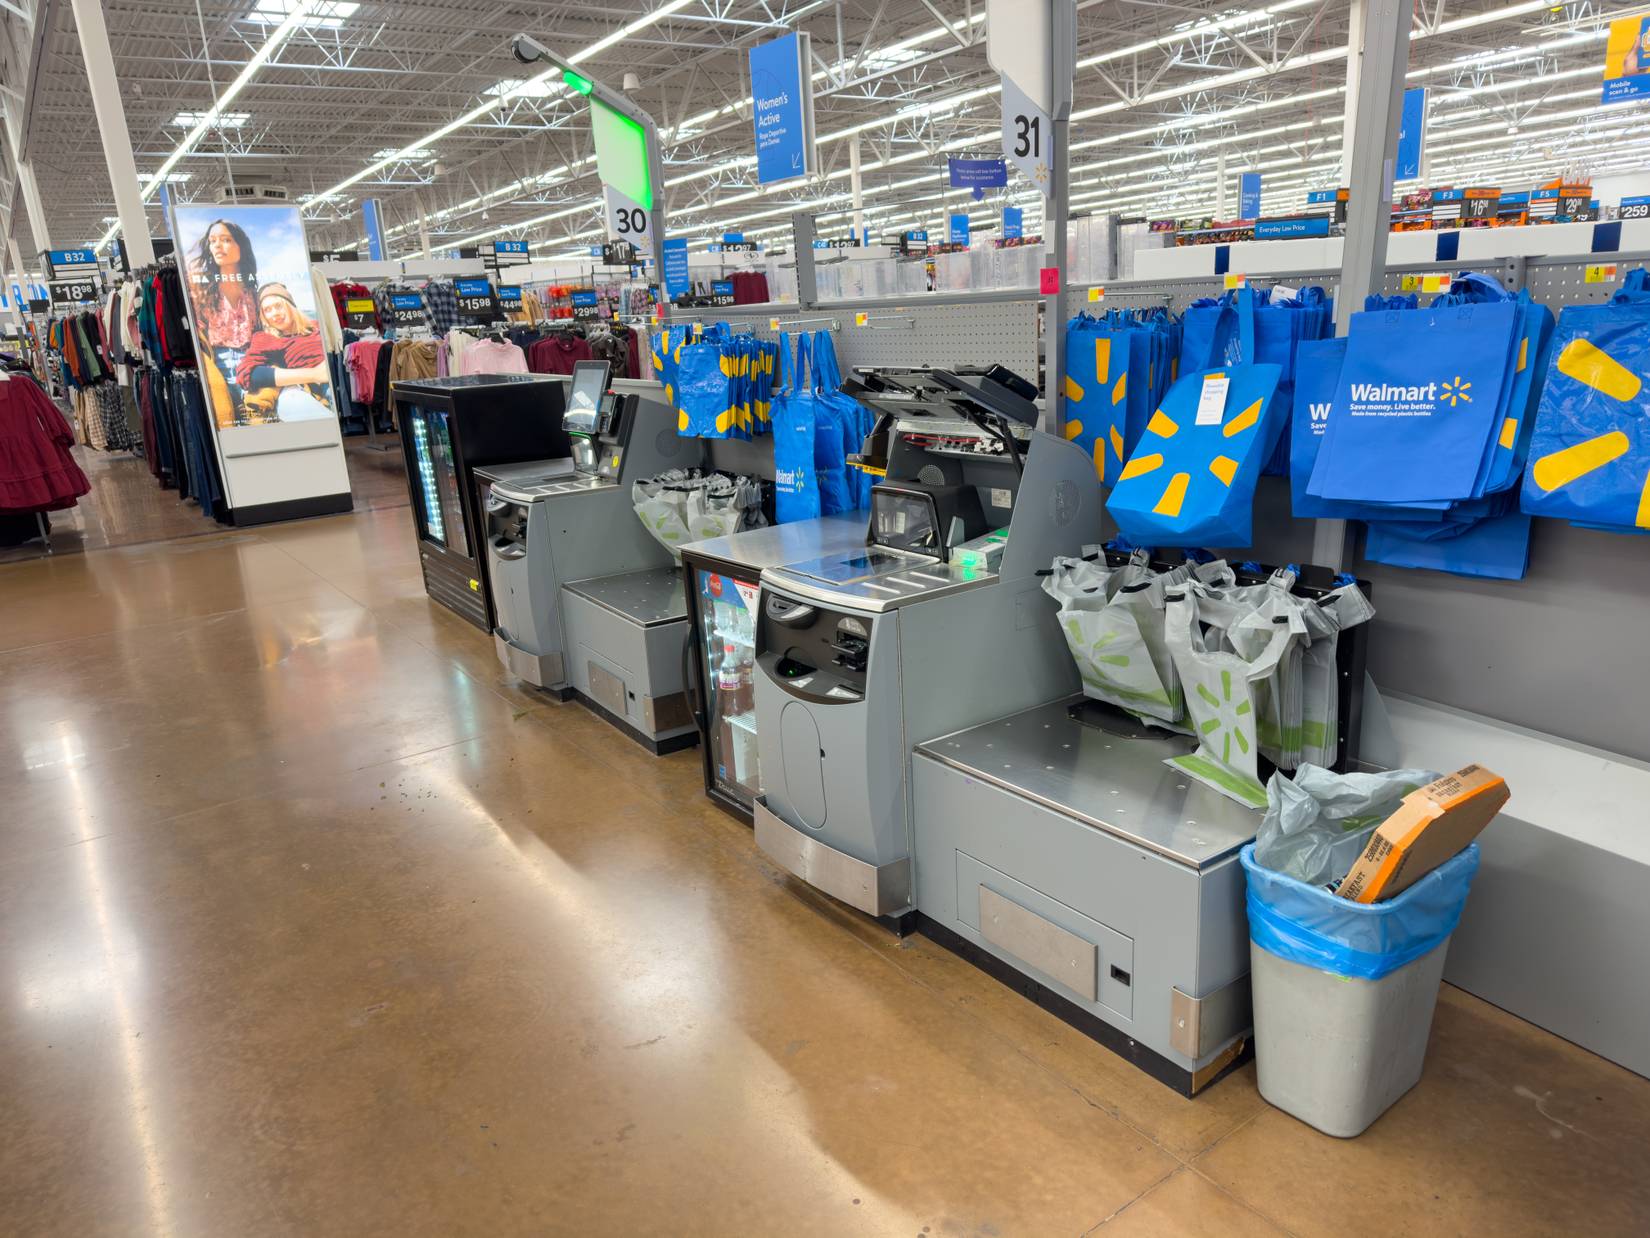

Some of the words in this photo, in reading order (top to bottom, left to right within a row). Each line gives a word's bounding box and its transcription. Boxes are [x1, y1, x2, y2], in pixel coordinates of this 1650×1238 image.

[1609, 81, 1631, 89] Mobile
[756, 92, 789, 112] Women's
[758, 112, 780, 127] Active
[1013, 113, 1040, 157] 31
[1316, 192, 1326, 202] F1
[1621, 204, 1649, 218] $259
[616, 208, 647, 233] 30
[1259, 224, 1281, 234] Everyday
[1282, 224, 1292, 232] Low
[1293, 223, 1305, 231] Price
[214, 272, 242, 282] FREE
[1351, 383, 1437, 401] Walmart
[1309, 403, 1331, 420] W
[1350, 402, 1366, 410] Save
[1367, 403, 1393, 412] money.
[1394, 402, 1409, 410] Live
[1410, 402, 1436, 410] better.
